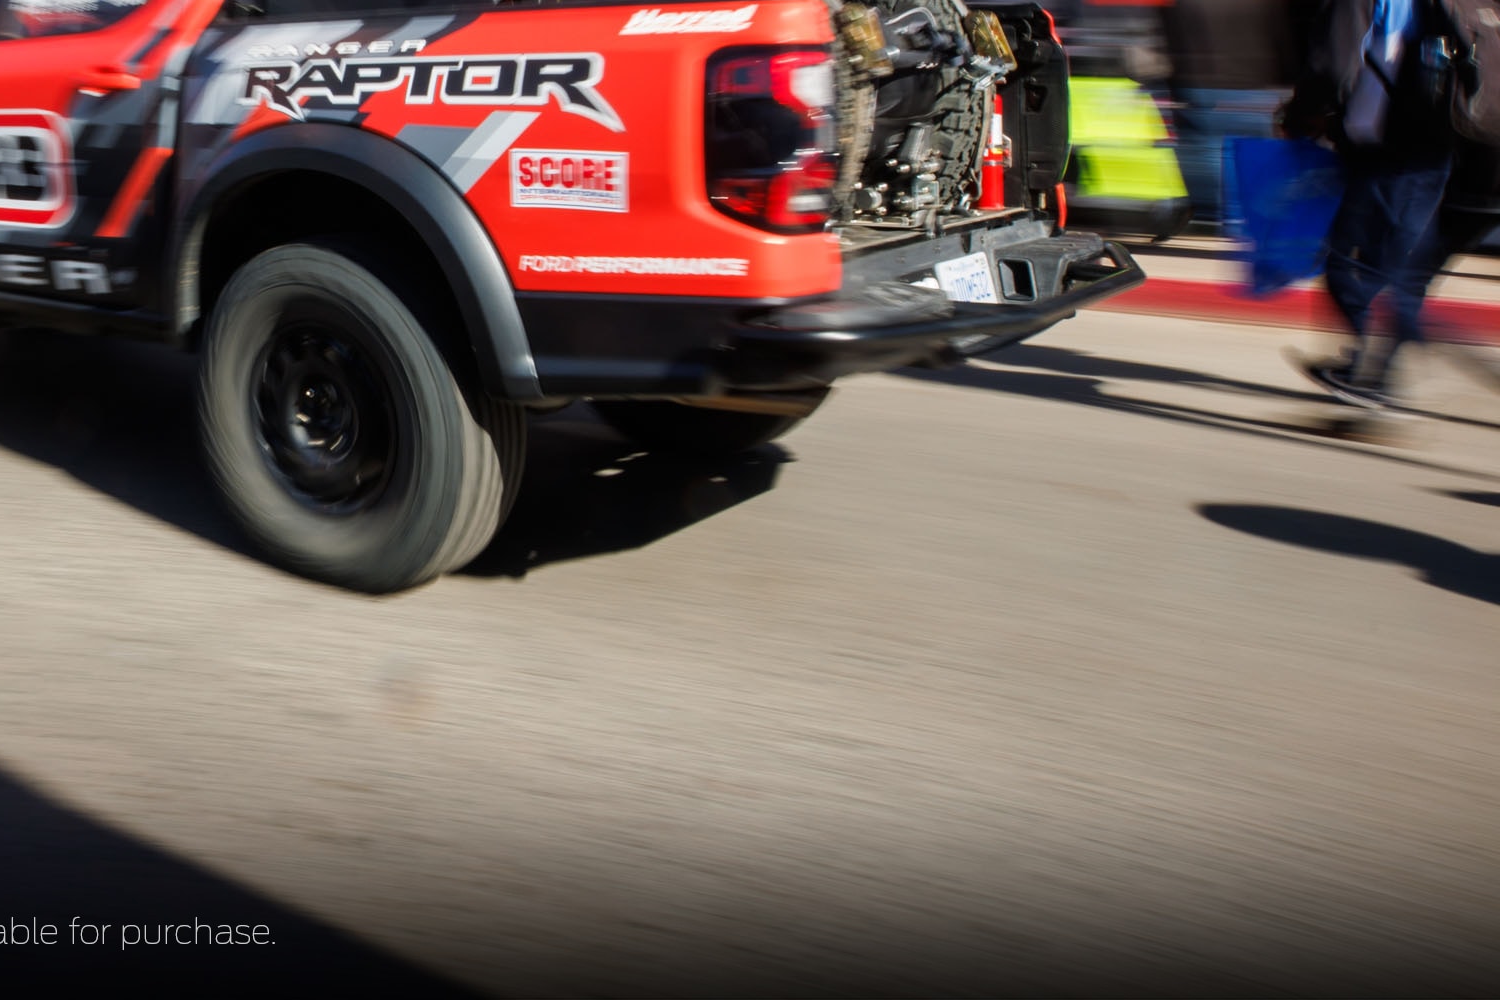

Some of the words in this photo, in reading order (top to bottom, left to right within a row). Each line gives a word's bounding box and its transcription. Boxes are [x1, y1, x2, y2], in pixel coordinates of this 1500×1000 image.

[248, 39, 427, 57] RANGER
[235, 52, 627, 133] RAPTOR
[518, 156, 620, 193] SCORE
